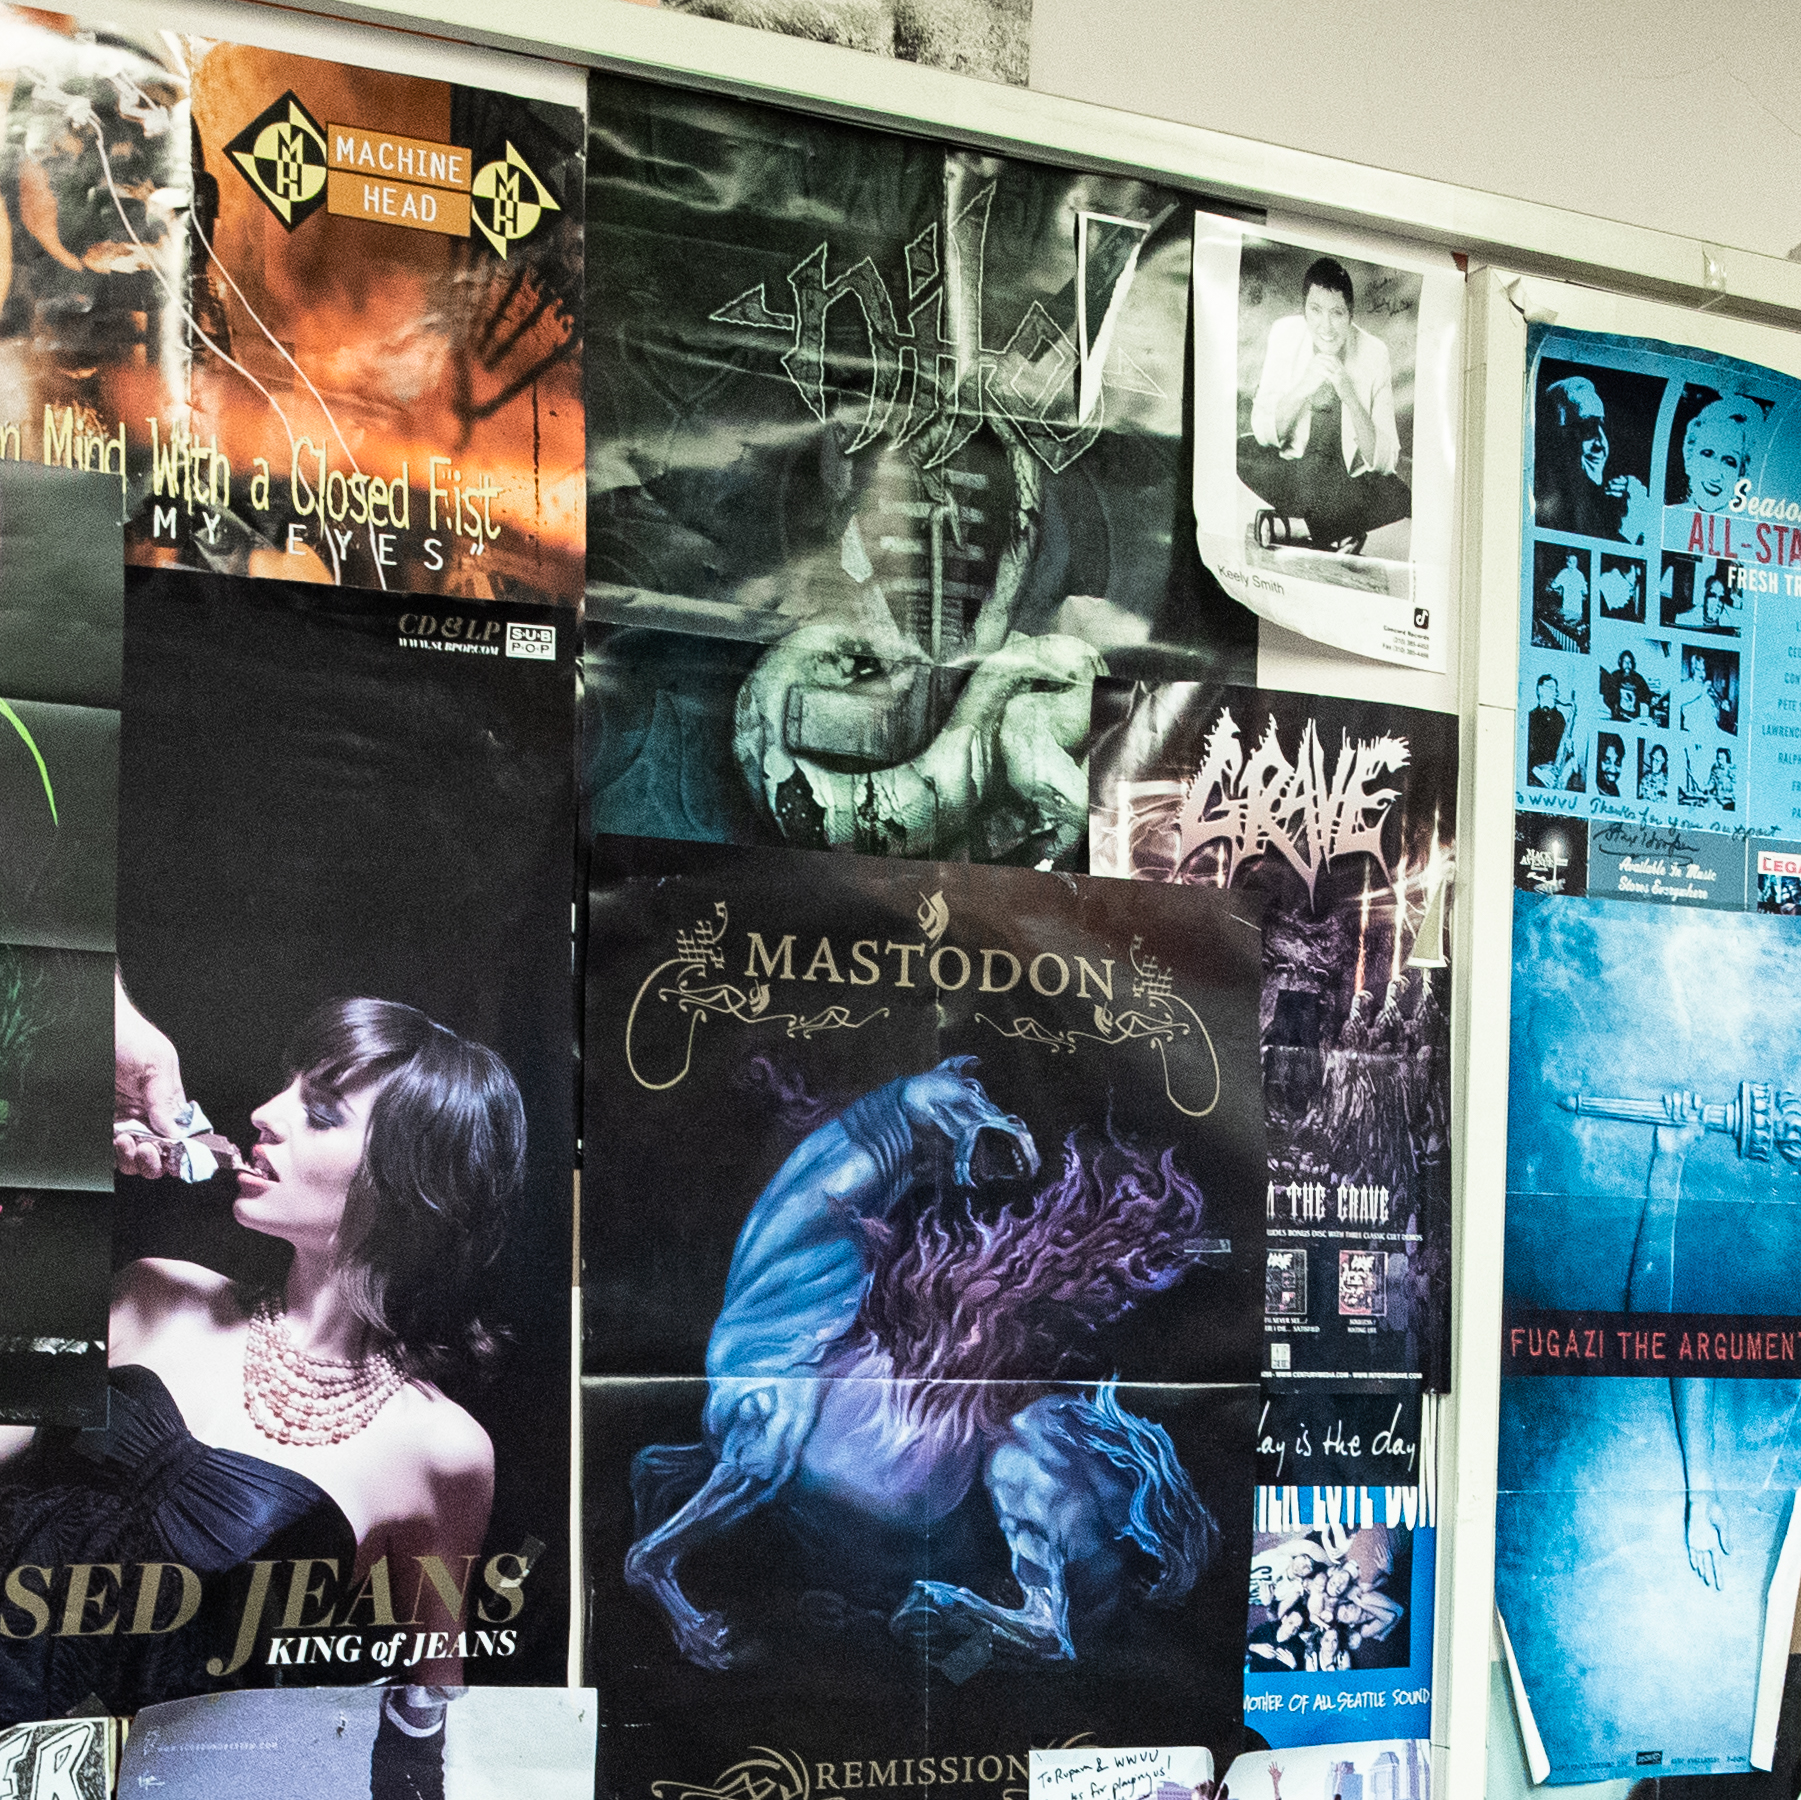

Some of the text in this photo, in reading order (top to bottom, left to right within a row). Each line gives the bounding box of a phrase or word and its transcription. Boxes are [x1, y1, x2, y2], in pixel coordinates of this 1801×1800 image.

[335, 134, 464, 186] MACHINE
[362, 186, 438, 223] HEAD
[150, 416, 409, 531] With a Closed
[1217, 564, 1285, 596] Keely Smith
[1726, 564, 1779, 594] FRESH
[399, 613, 500, 641] CD & LP
[1530, 795, 1578, 810] WWVU
[744, 931, 1116, 1001] MASTODON
[1286, 1181, 1326, 1223] THE
[1337, 1182, 1389, 1224] GRAVE
[1510, 1327, 1605, 1360] FUGAZI
[1617, 1330, 1666, 1361] THE
[1296, 1419, 1362, 1457] is the
[206, 1550, 533, 1677] JEANS
[265, 1628, 519, 1668] KING of JEANS
[1289, 1690, 1386, 1713] OF ALL SEATTLE
[815, 1753, 1029, 1790] REMISSION
[1038, 1749, 1159, 1788] To WWVU
